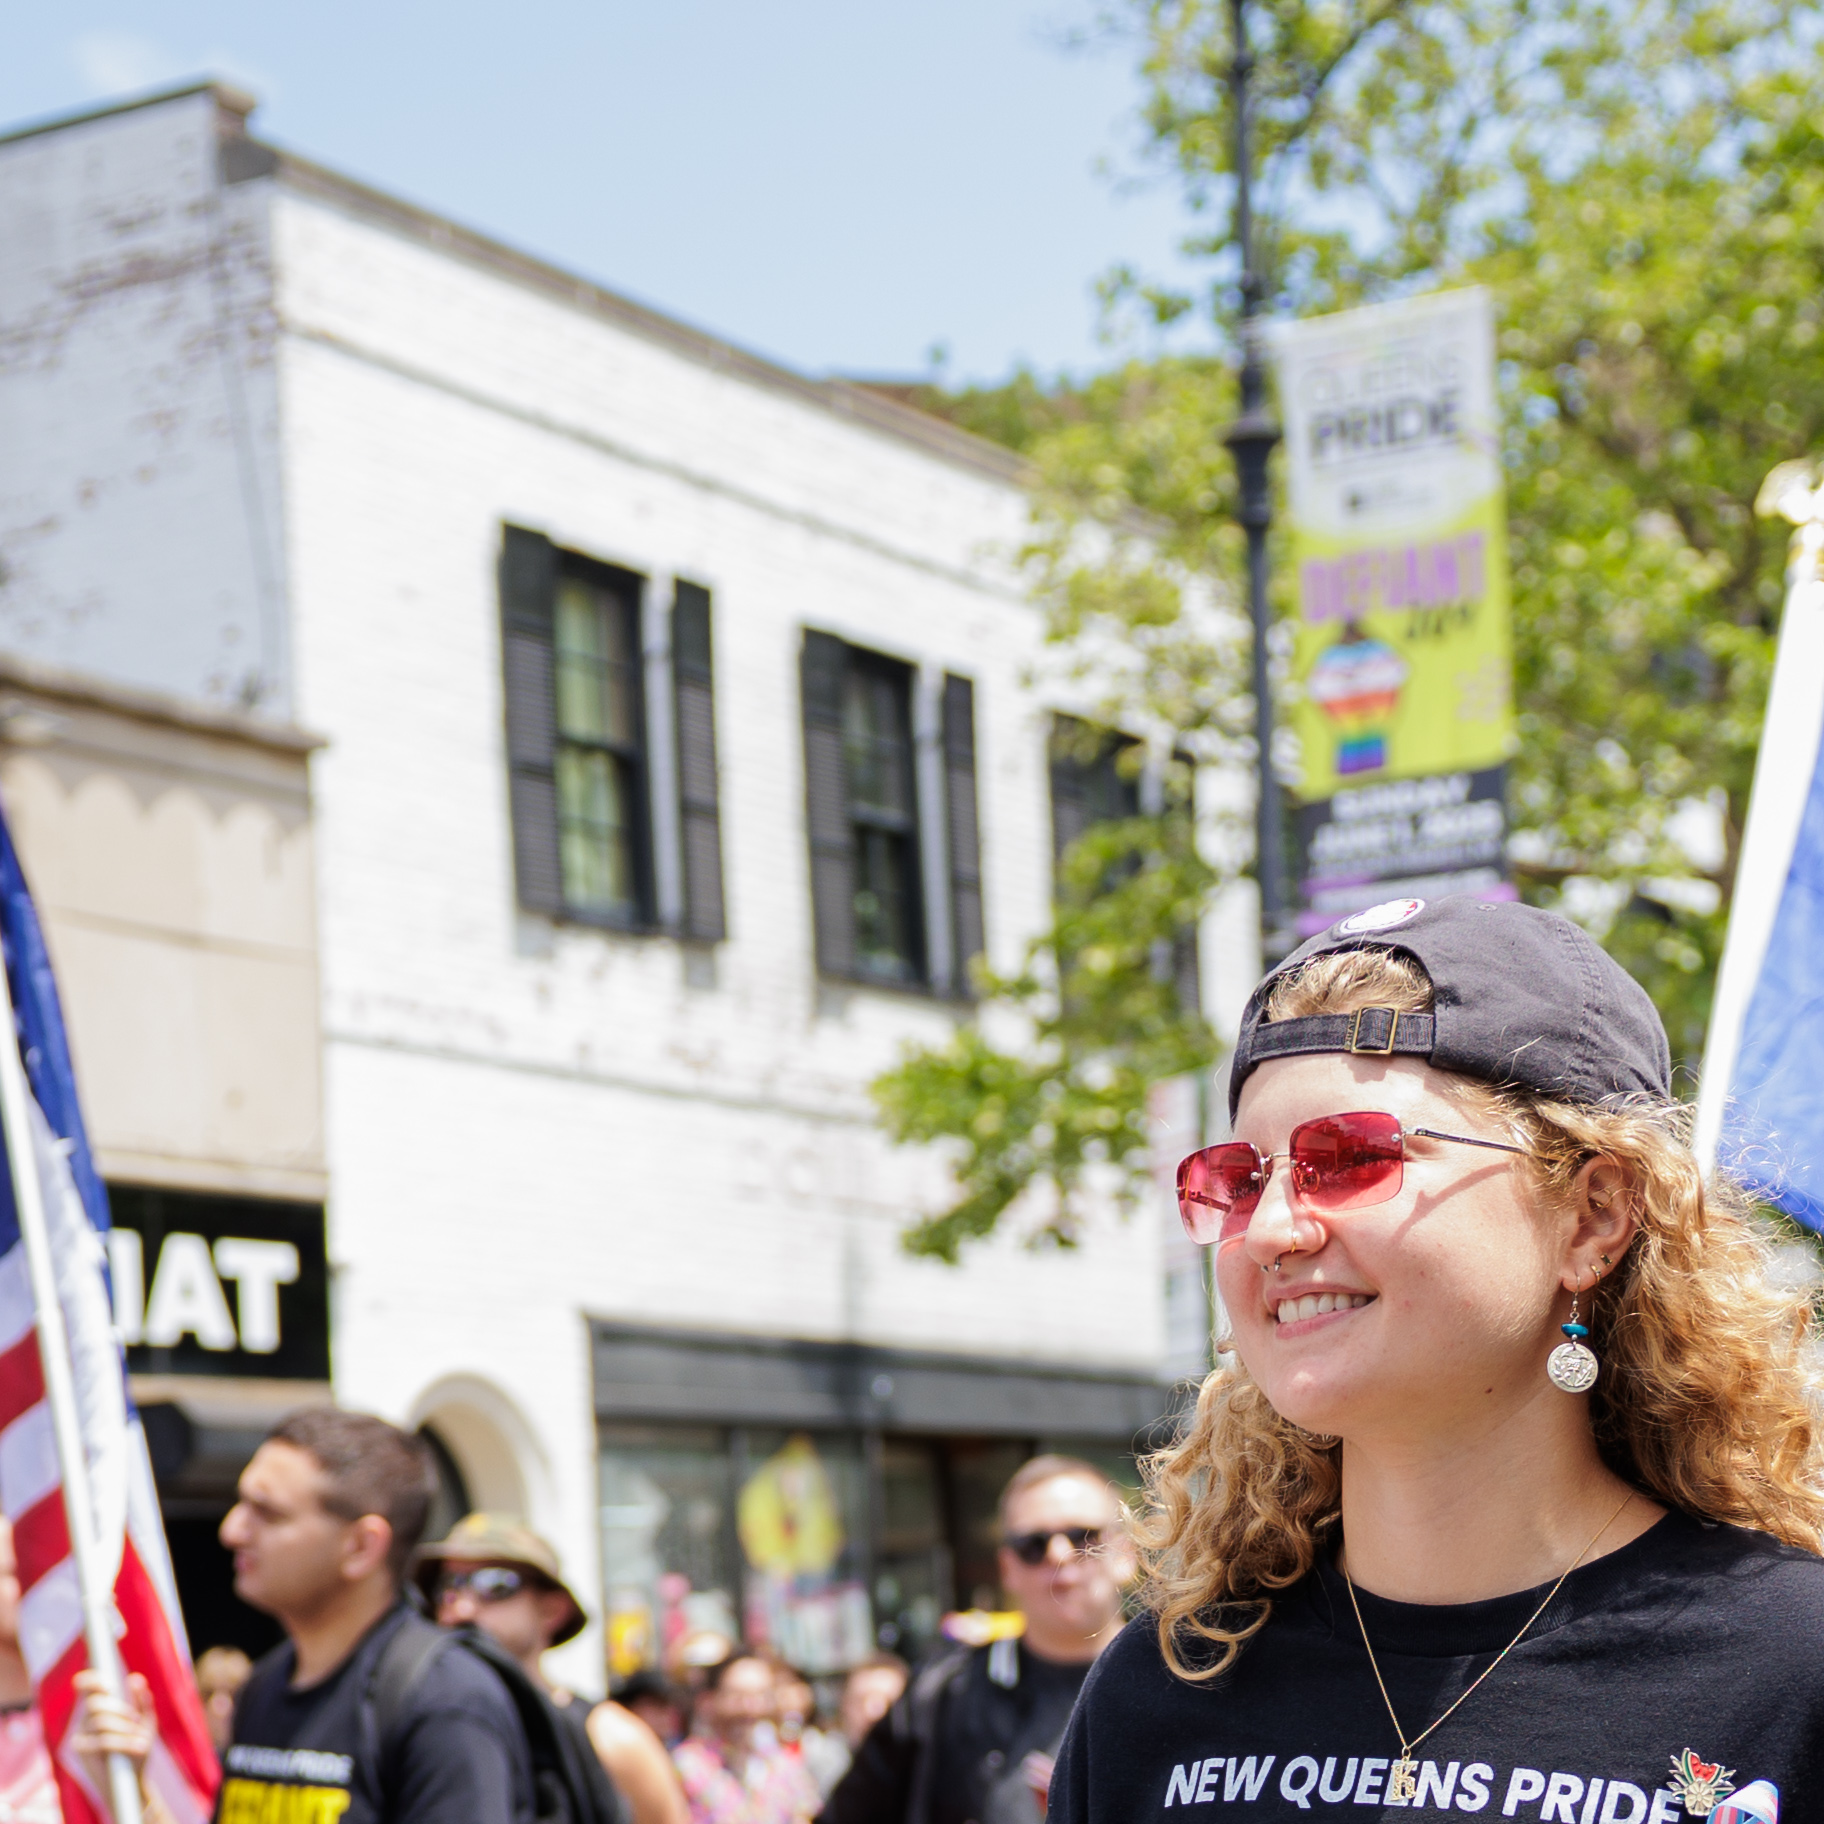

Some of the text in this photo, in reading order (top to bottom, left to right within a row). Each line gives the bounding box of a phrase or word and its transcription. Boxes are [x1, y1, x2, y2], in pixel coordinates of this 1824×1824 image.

[1310, 388, 1464, 462] PRIDE
[1300, 533, 1489, 625] DEFIANT
[1163, 1754, 1276, 1808] NEW
[1279, 1755, 1495, 1814] QUEENS
